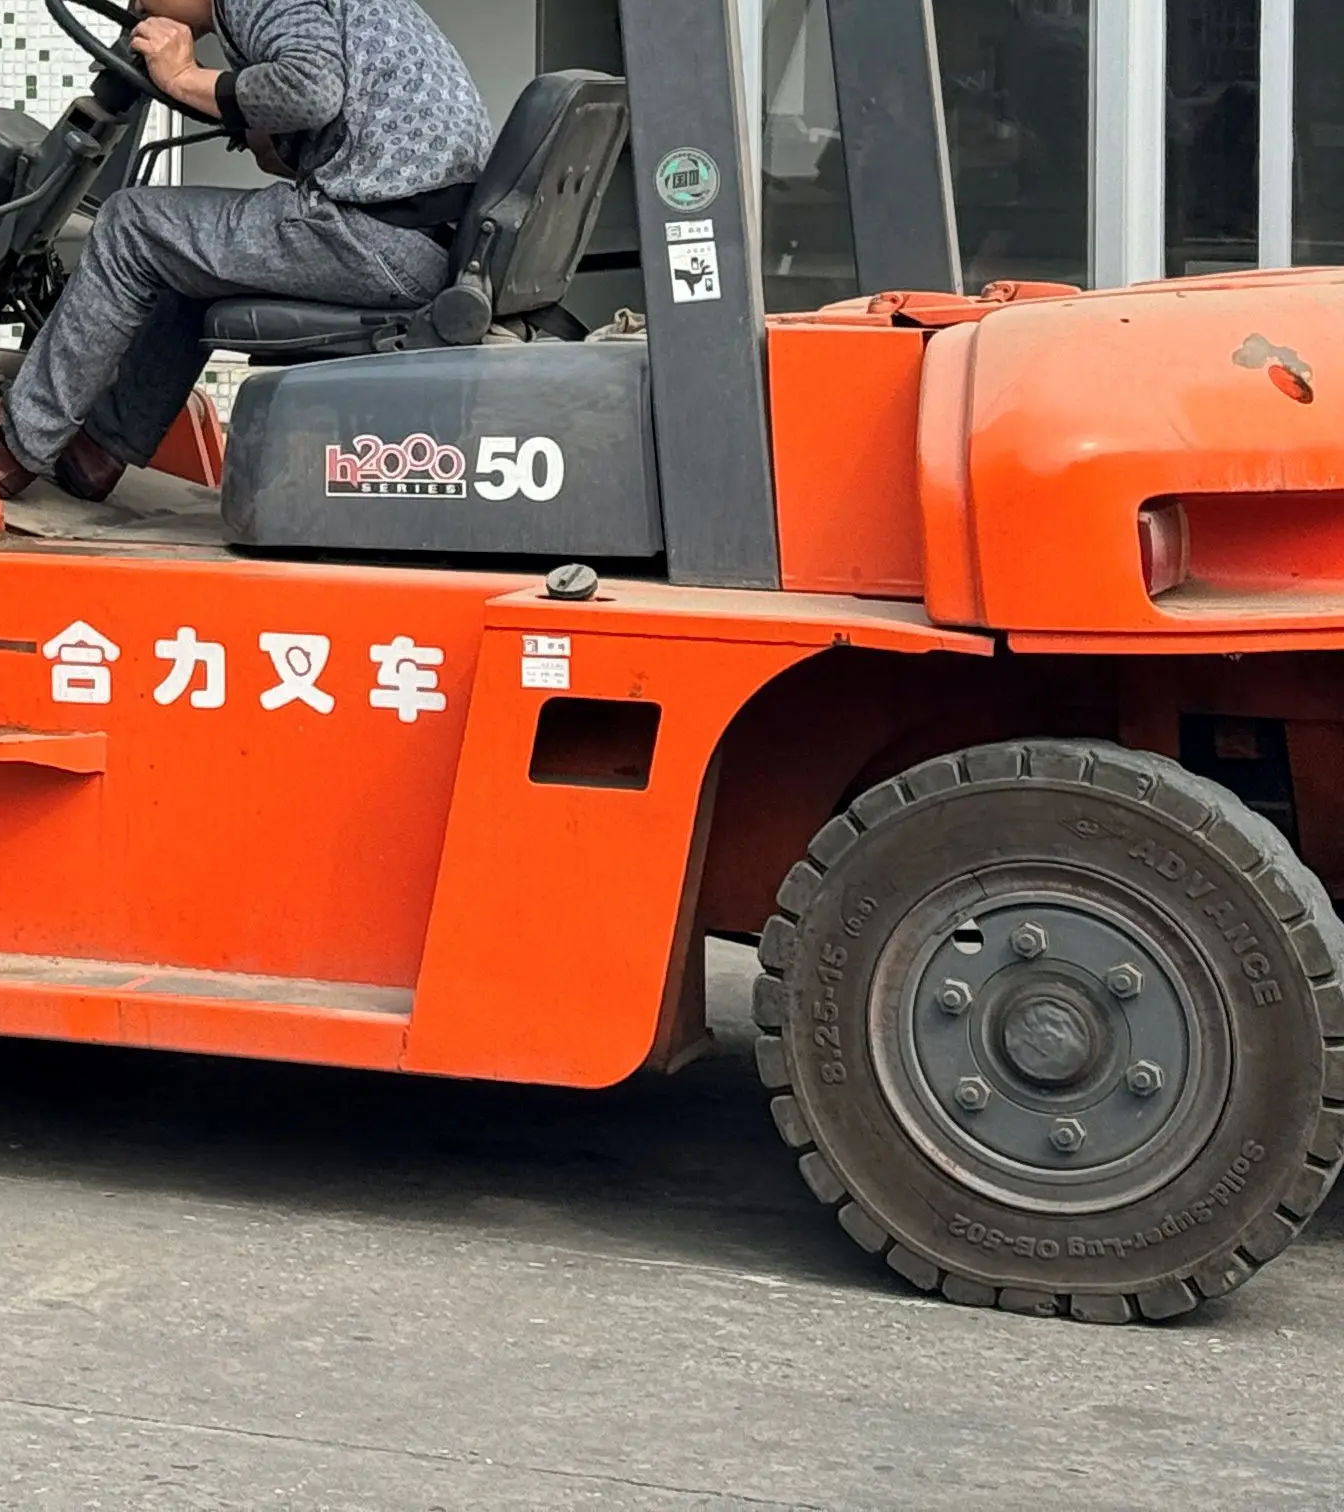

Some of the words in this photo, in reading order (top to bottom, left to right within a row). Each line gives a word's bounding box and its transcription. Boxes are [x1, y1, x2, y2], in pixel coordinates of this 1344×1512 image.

[325, 433, 466, 488] h2000
[473, 436, 564, 502] 50
[360, 483, 458, 494] SERIES
[42, 619, 448, 724] 合力叉车
[1128, 837, 1283, 1007] ADVANCE
[813, 942, 849, 1085] 8.25-15
[947, 1212, 1061, 1260] OB-502
